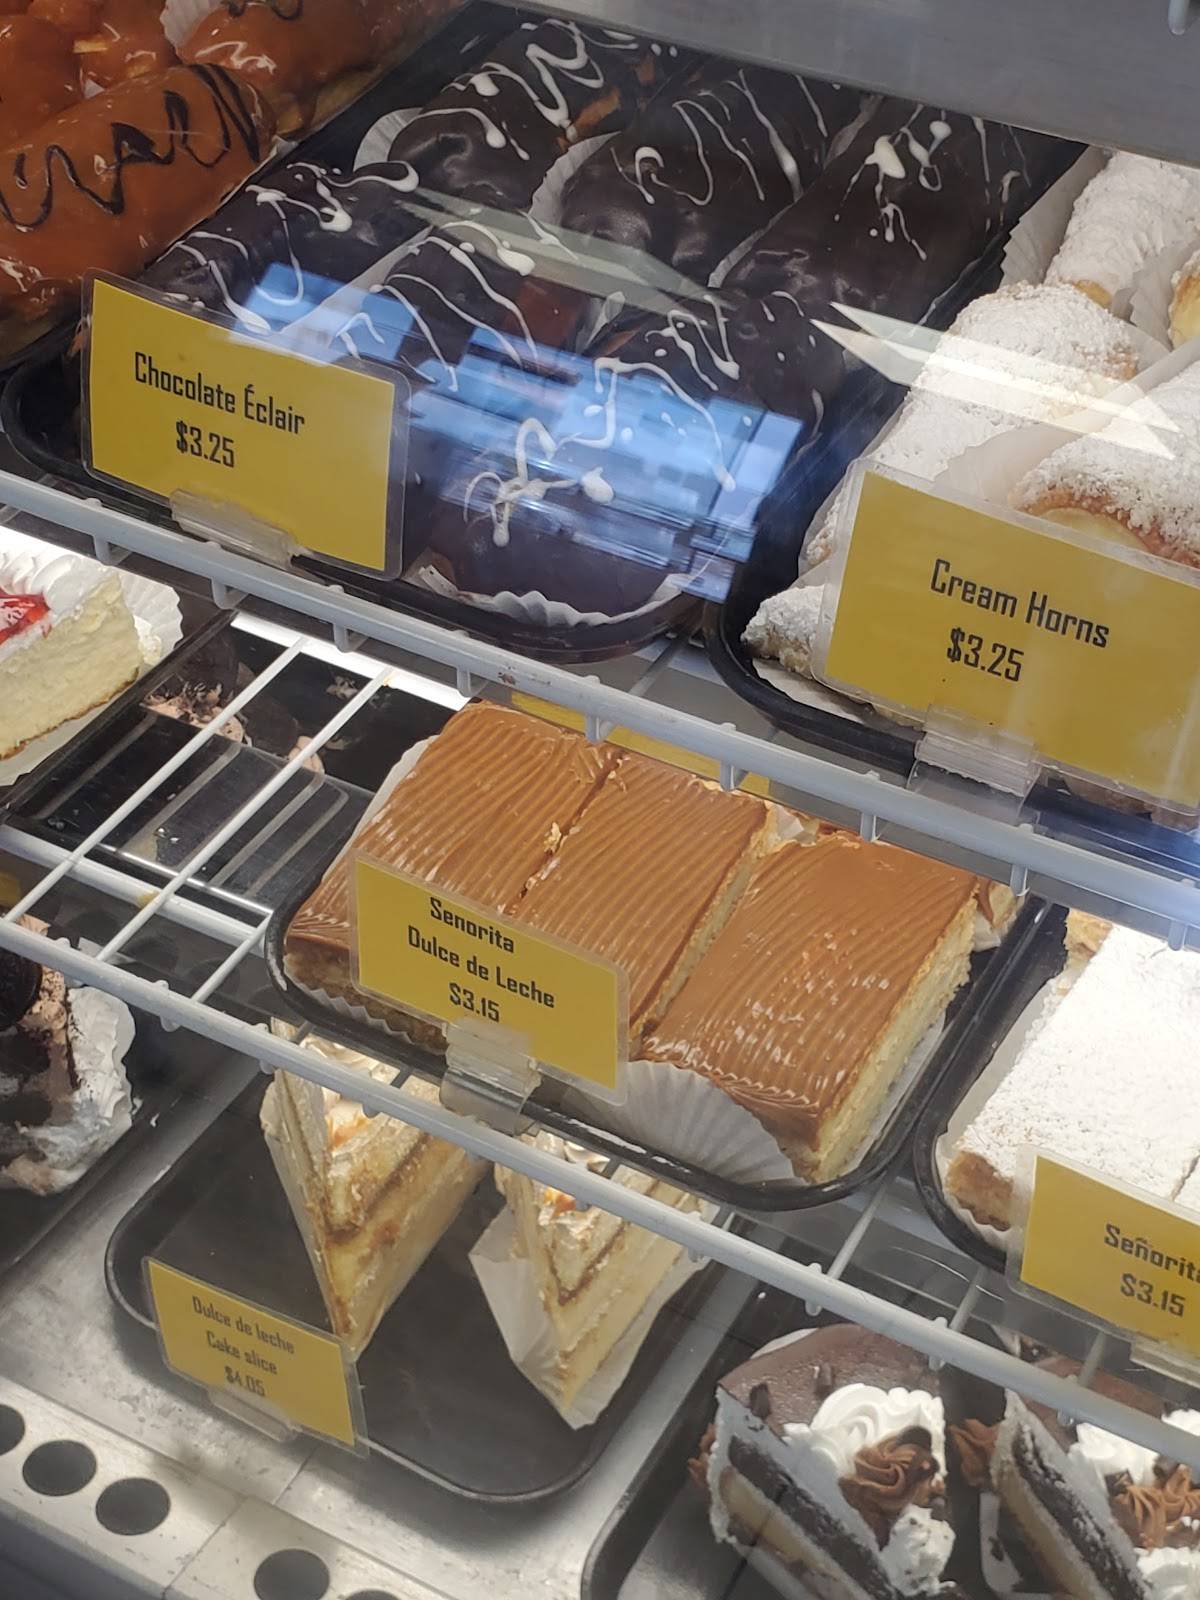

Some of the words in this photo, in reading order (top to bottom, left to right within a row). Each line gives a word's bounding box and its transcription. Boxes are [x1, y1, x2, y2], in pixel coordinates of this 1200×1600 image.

[134, 351, 236, 414] Chocolate
[243, 383, 306, 436] Éclair
[175, 420, 235, 468] $3.25
[930, 558, 1018, 619] Cream
[1025, 591, 1110, 648] Horns
[947, 627, 1025, 683] $3.25
[408, 925, 460, 967] Dulce
[466, 955, 489, 981] de
[496, 966, 555, 1008] Leche
[449, 982, 500, 1022] $3.15
[1120, 1272, 1186, 1317] $3.15
[192, 1295, 231, 1328] Dulce
[235, 1316, 253, 1336] de
[256, 1323, 295, 1354] leche
[206, 1329, 240, 1359] Cake
[244, 1350, 278, 1375] slice
[224, 1365, 265, 1397] $4.05
